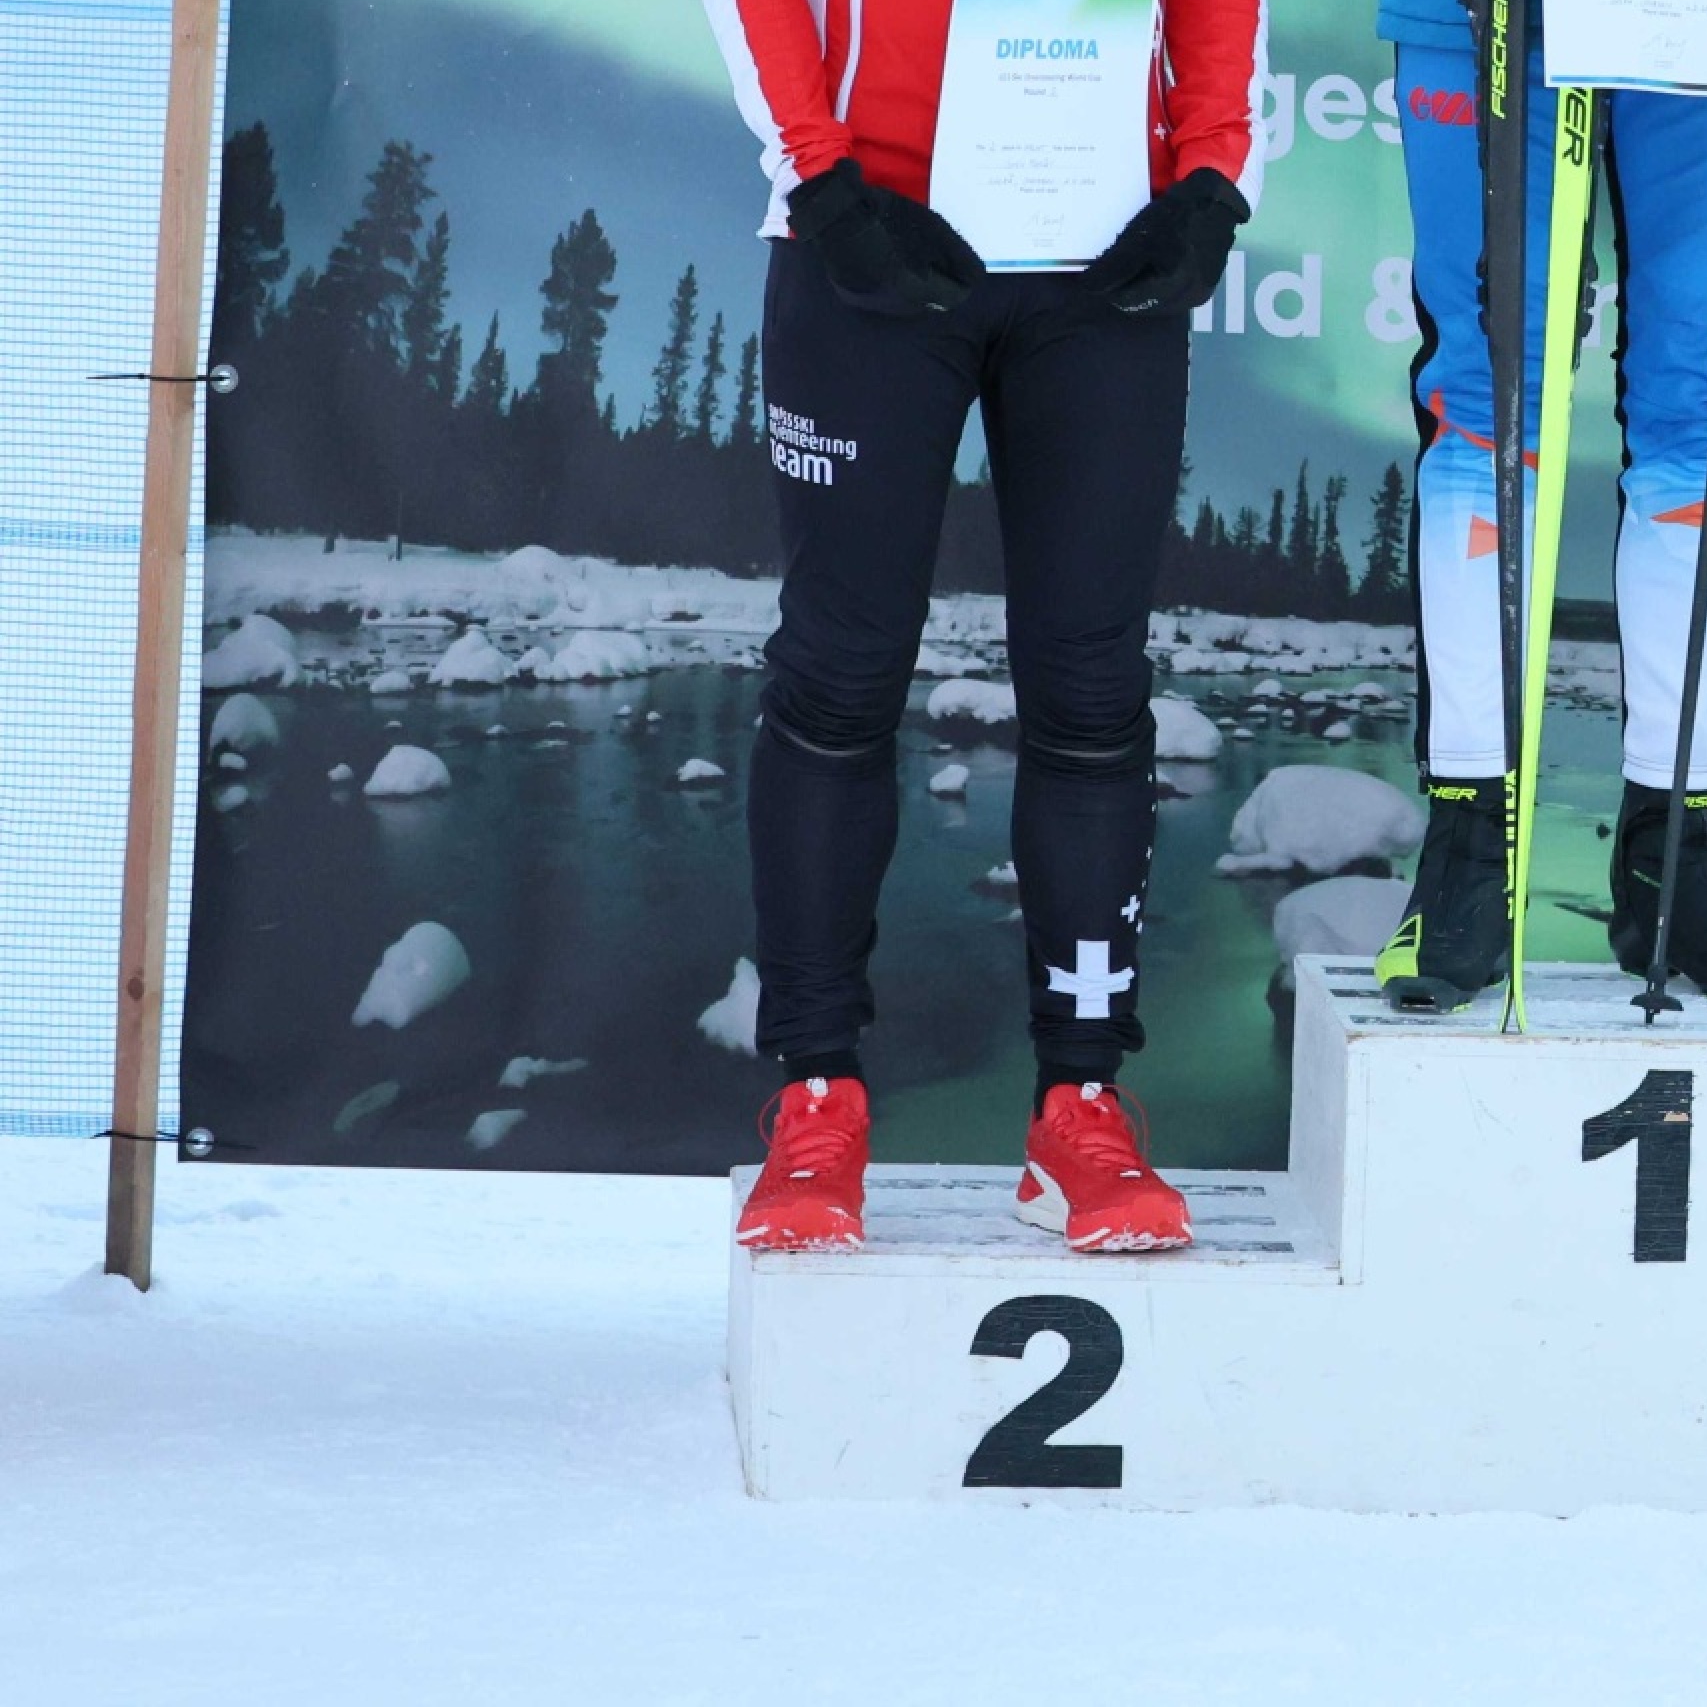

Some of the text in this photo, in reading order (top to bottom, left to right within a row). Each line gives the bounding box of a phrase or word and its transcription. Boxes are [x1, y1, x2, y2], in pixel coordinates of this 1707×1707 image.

[996, 38, 1099, 60] DIPLOMA
[1582, 1070, 1695, 1263] 1
[962, 1295, 1125, 1488] 2
